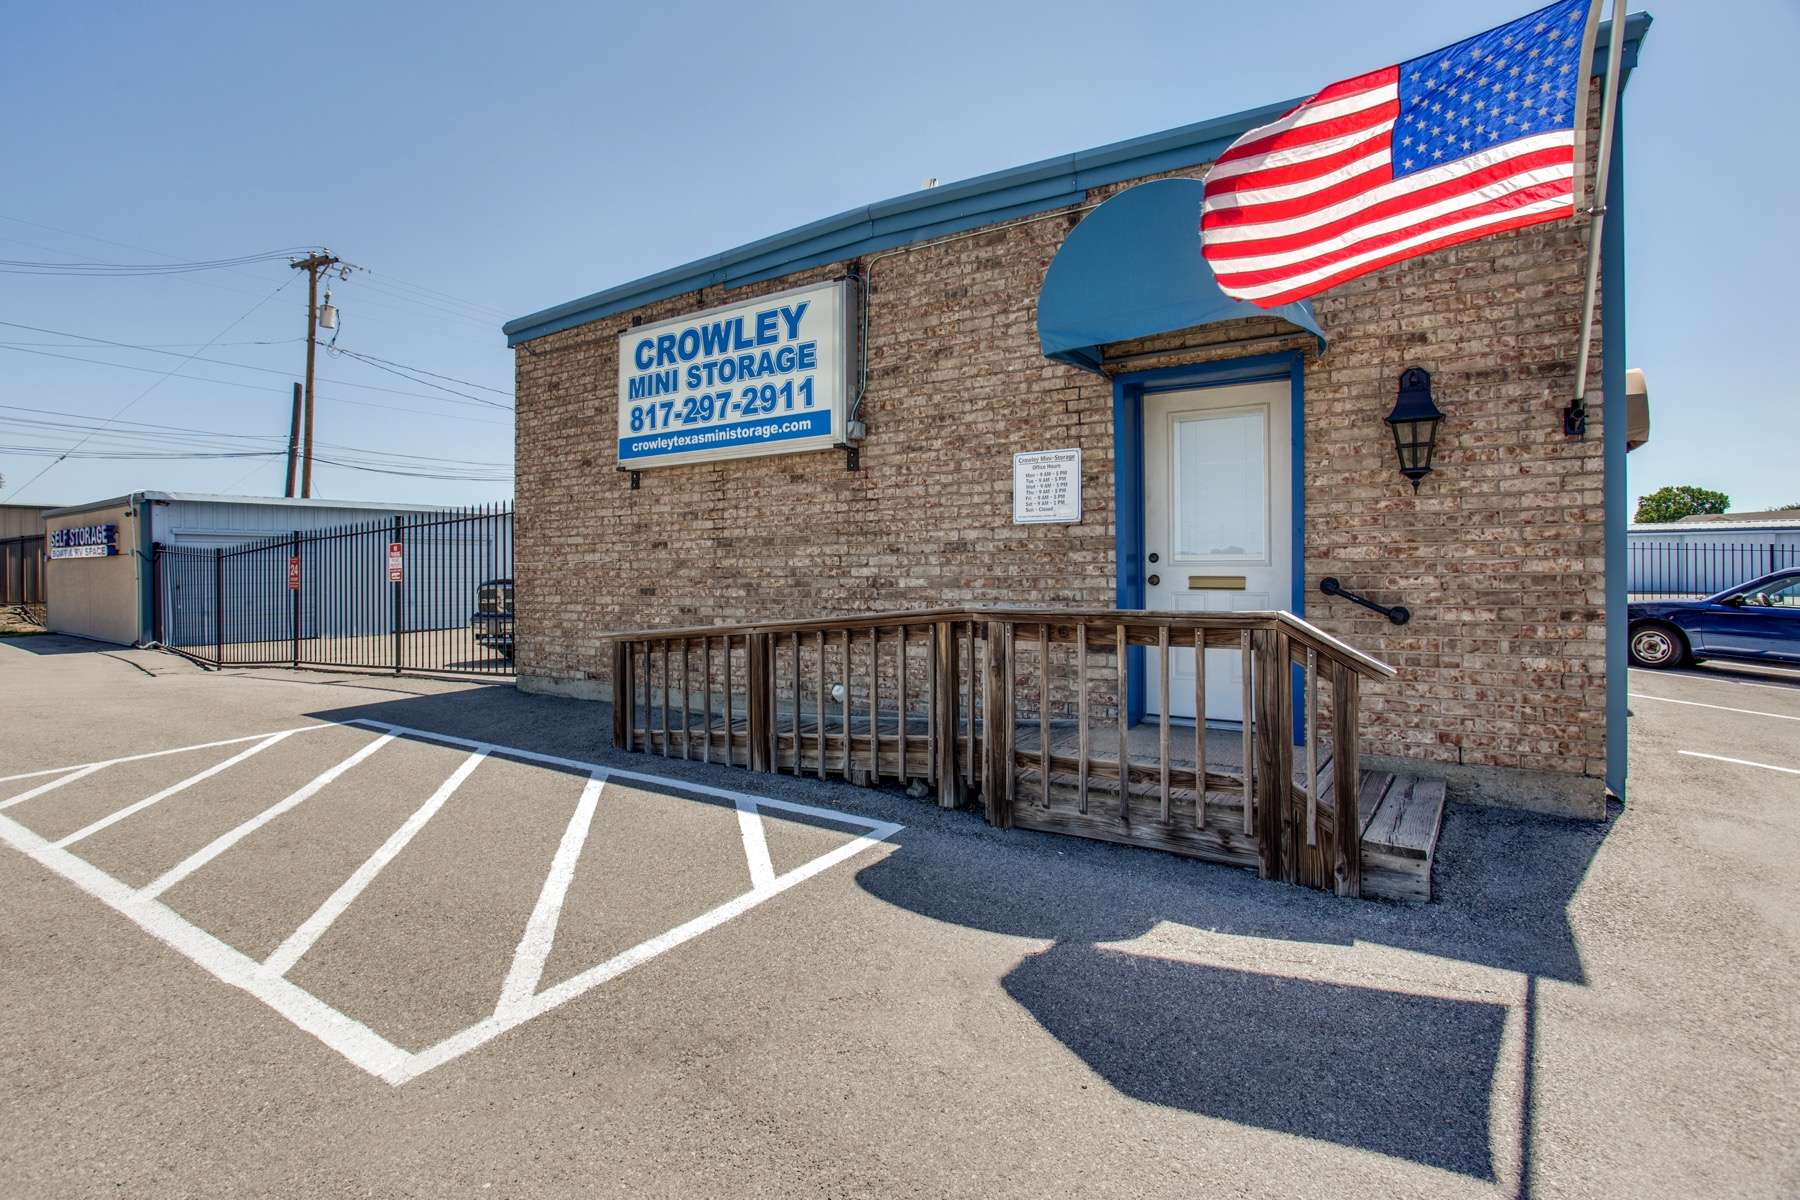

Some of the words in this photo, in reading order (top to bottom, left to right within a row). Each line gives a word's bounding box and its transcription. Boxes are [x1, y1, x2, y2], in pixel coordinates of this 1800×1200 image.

[635, 300, 811, 370] CROWLEY
[628, 368, 679, 401] MINI
[687, 340, 817, 390] STORAGE
[631, 376, 815, 433] 817-297-2911
[632, 419, 811, 452] crowleytexasministorage.com
[1019, 456, 1039, 464] Crowley
[51, 530, 67, 546] SELF
[69, 525, 107, 545] STORAGE
[84, 546, 106, 556] SPACE
[290, 564, 299, 576] 24
